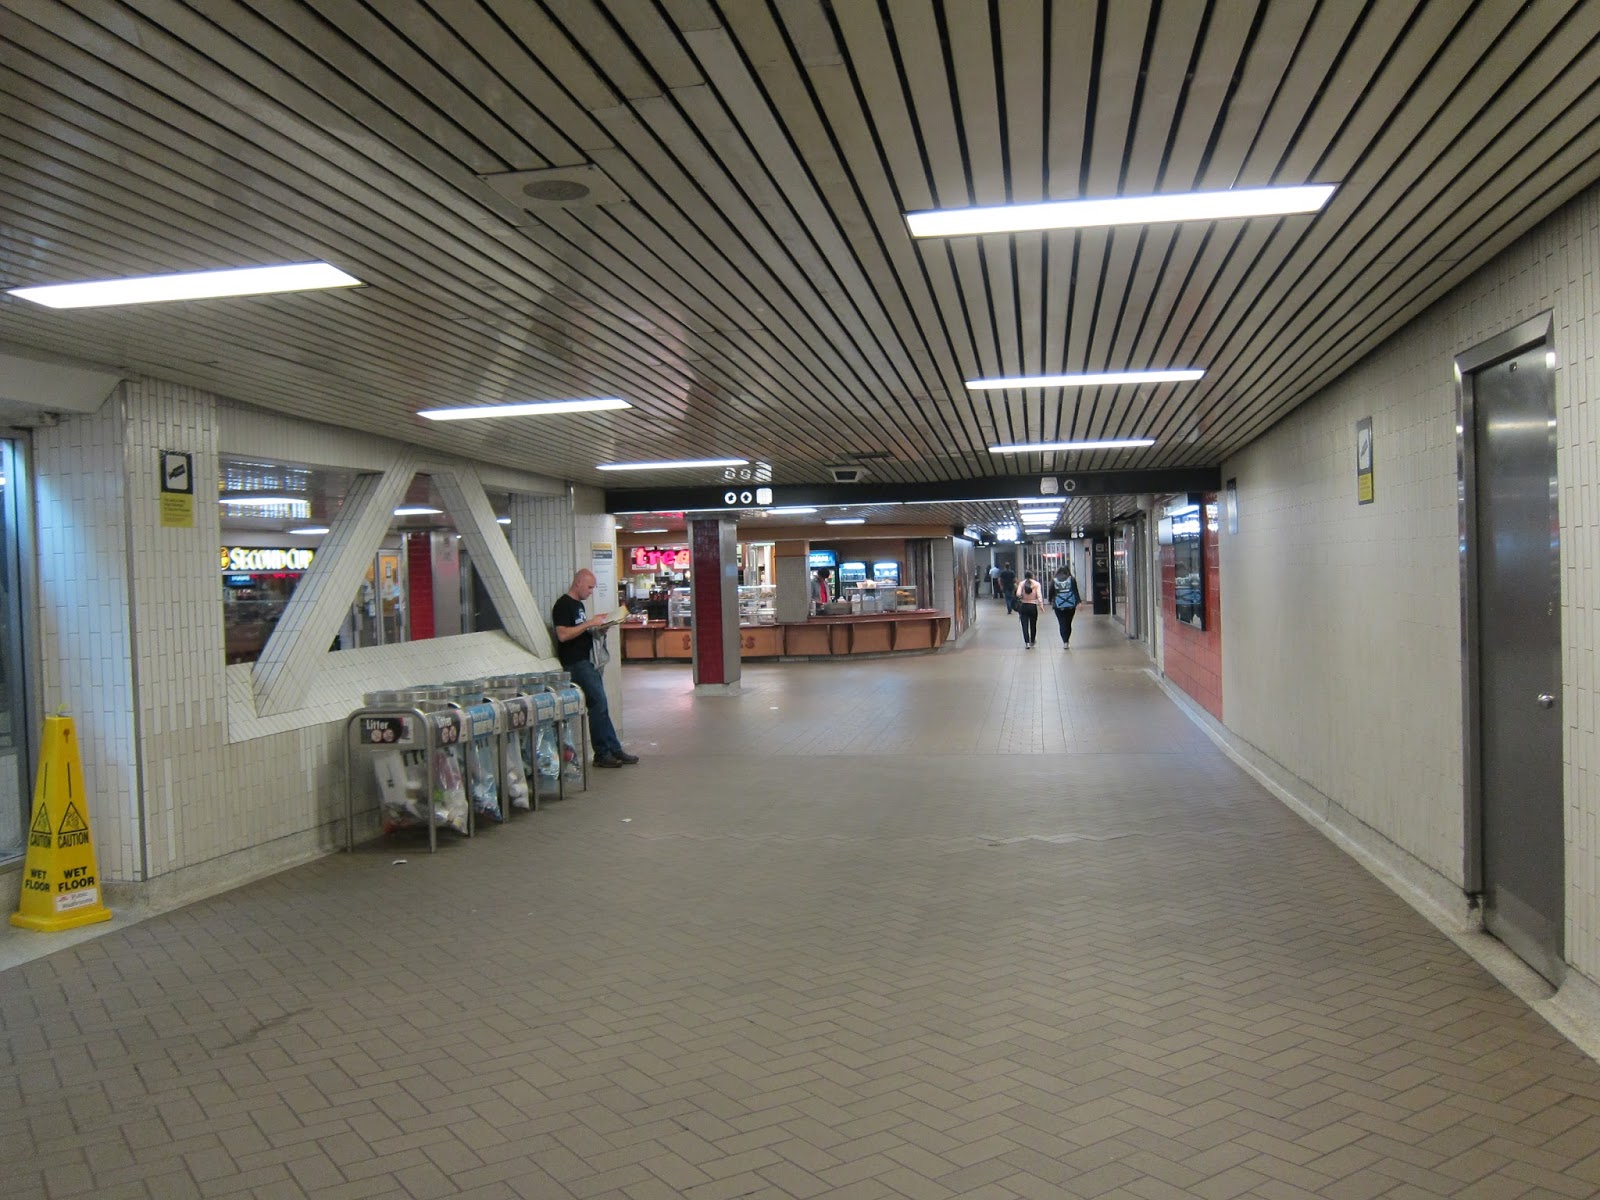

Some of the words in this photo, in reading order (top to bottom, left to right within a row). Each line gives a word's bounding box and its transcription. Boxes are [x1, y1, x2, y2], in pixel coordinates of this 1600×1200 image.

[230, 547, 286, 570] SECOND
[286, 548, 314, 570] CUP
[635, 546, 690, 566] trea
[366, 719, 389, 730] Litter
[30, 833, 51, 848] CAUTION
[58, 831, 89, 848] CAUTION
[30, 869, 47, 879] WET
[64, 866, 87, 879] WET
[25, 879, 51, 892] FLOOR
[58, 876, 95, 892] FLOOR
